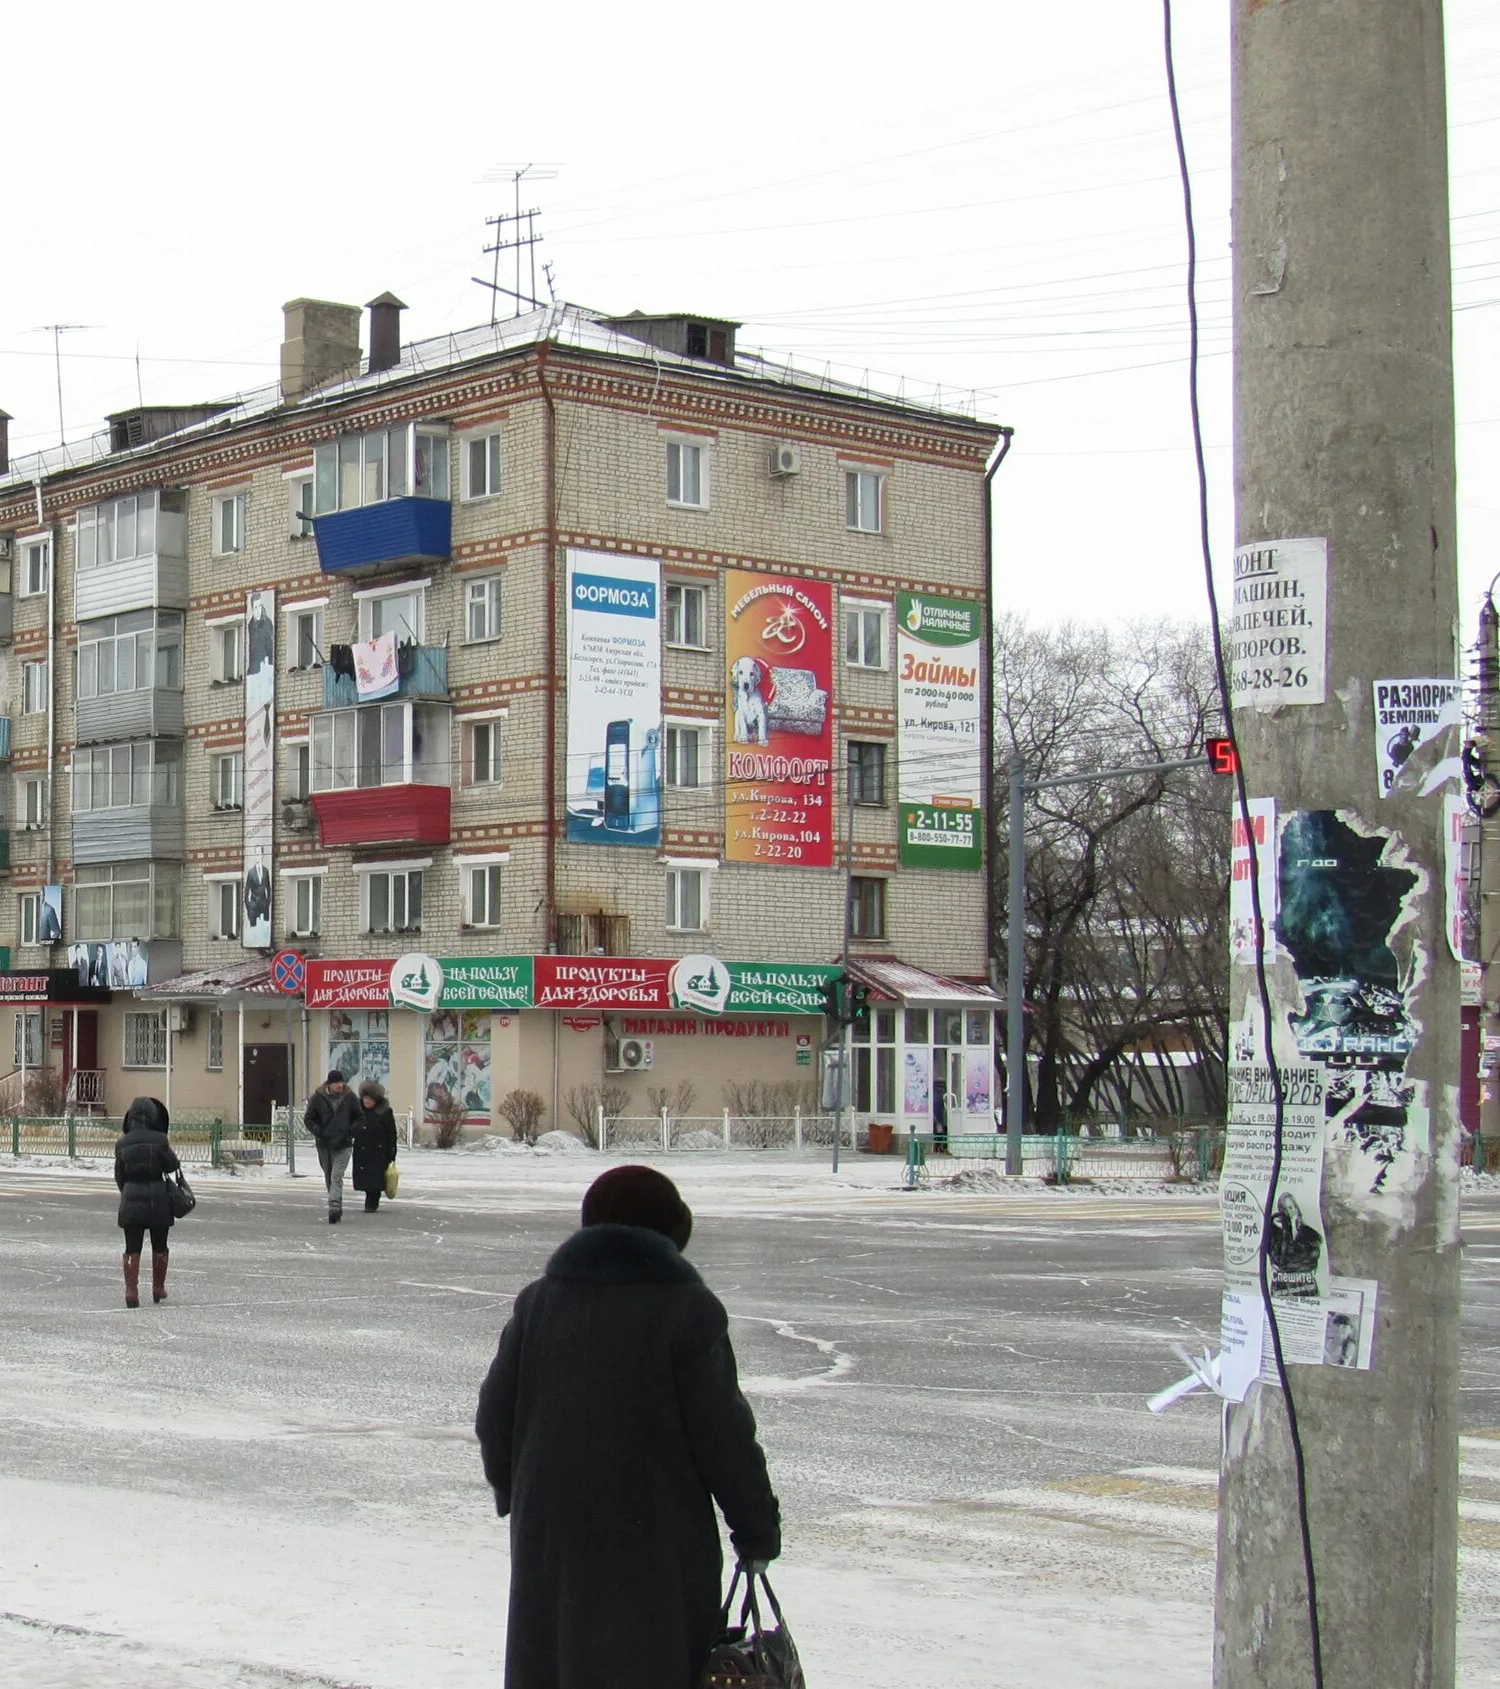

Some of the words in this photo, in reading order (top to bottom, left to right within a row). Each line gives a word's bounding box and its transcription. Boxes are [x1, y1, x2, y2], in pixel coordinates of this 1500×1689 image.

[575, 585, 649, 608] ФОРМОЗА
[731, 584, 794, 618] МЕБЕЛЬНЫЙ
[795, 592, 828, 629] САЛОН
[923, 606, 971, 621] ОТЛИЧНЫЕ
[922, 617, 971, 632] НАЛИЧНЫЕ
[612, 637, 647, 647] ФОРМОЗА
[900, 653, 977, 687] Займы
[904, 718, 918, 729] ул.
[921, 718, 957, 733] Кирова,
[960, 721, 975, 733] 121
[728, 752, 829, 786] КОМФОРТ
[916, 810, 973, 831] 2-11-55
[909, 831, 972, 845] 8-800-550-77-77
[754, 844, 803, 859] 2-22-20
[323, 968, 382, 983] ПРОДУКТЫ
[450, 967, 467, 981] НА
[470, 966, 520, 983] ПОЛЬЗУ
[555, 966, 646, 982] ПРОДУКТЫ
[741, 970, 762, 985] НА
[766, 972, 828, 987] ПОЛЬЗУ
[312, 987, 333, 1003] ДЛЯ
[336, 987, 389, 1002] ЗДОРОВЬЯ
[443, 988, 474, 1001] ВСЕЙ
[478, 986, 528, 1001] СЕМЬЕ!
[540, 986, 577, 1002] ДЛЯ
[578, 986, 659, 1003] ЗДОРОВЬЯ
[730, 991, 772, 1004] ВСЕЙ
[622, 1017, 697, 1035] МАГАЗИН
[705, 1019, 789, 1037] ПРОДУКТЫ
